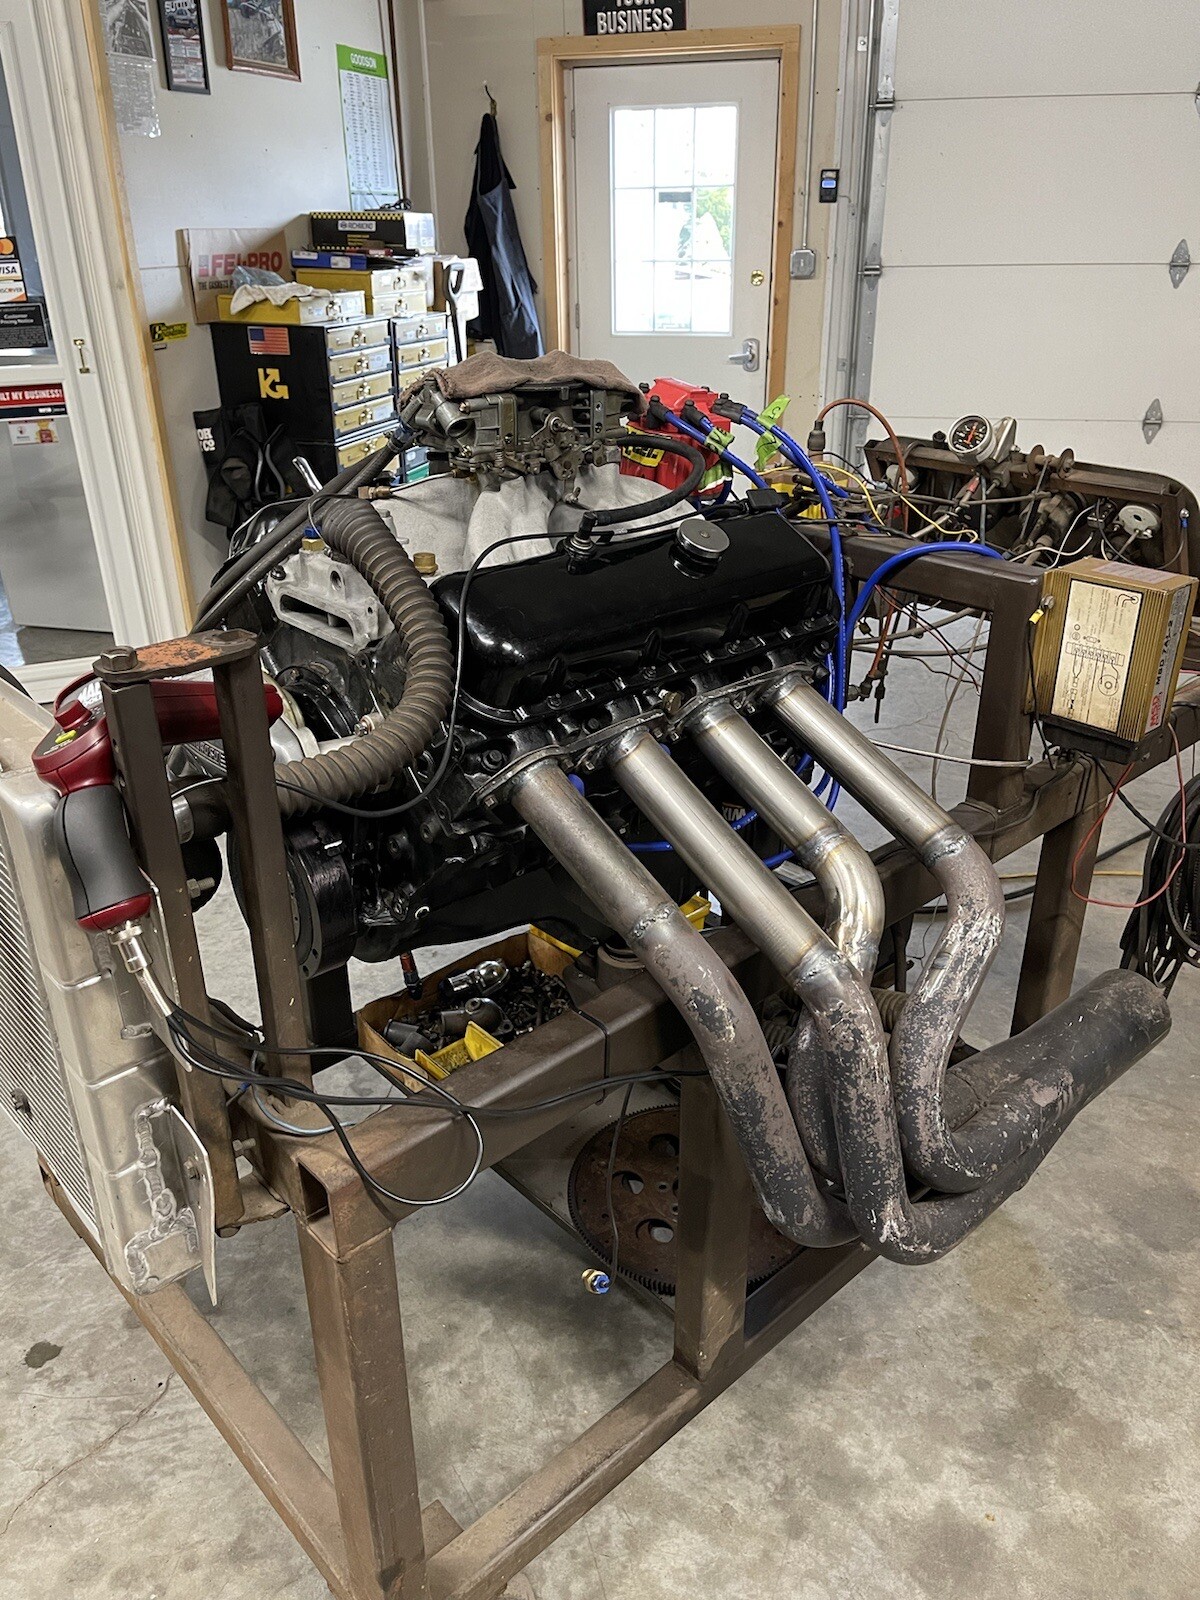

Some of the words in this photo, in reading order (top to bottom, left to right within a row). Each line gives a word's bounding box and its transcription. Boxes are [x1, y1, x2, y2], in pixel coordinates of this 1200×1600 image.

[596, 7, 674, 35] BUSINESS
[11, 391, 23, 401] MY
[24, 389, 63, 400] BUSINESS!
